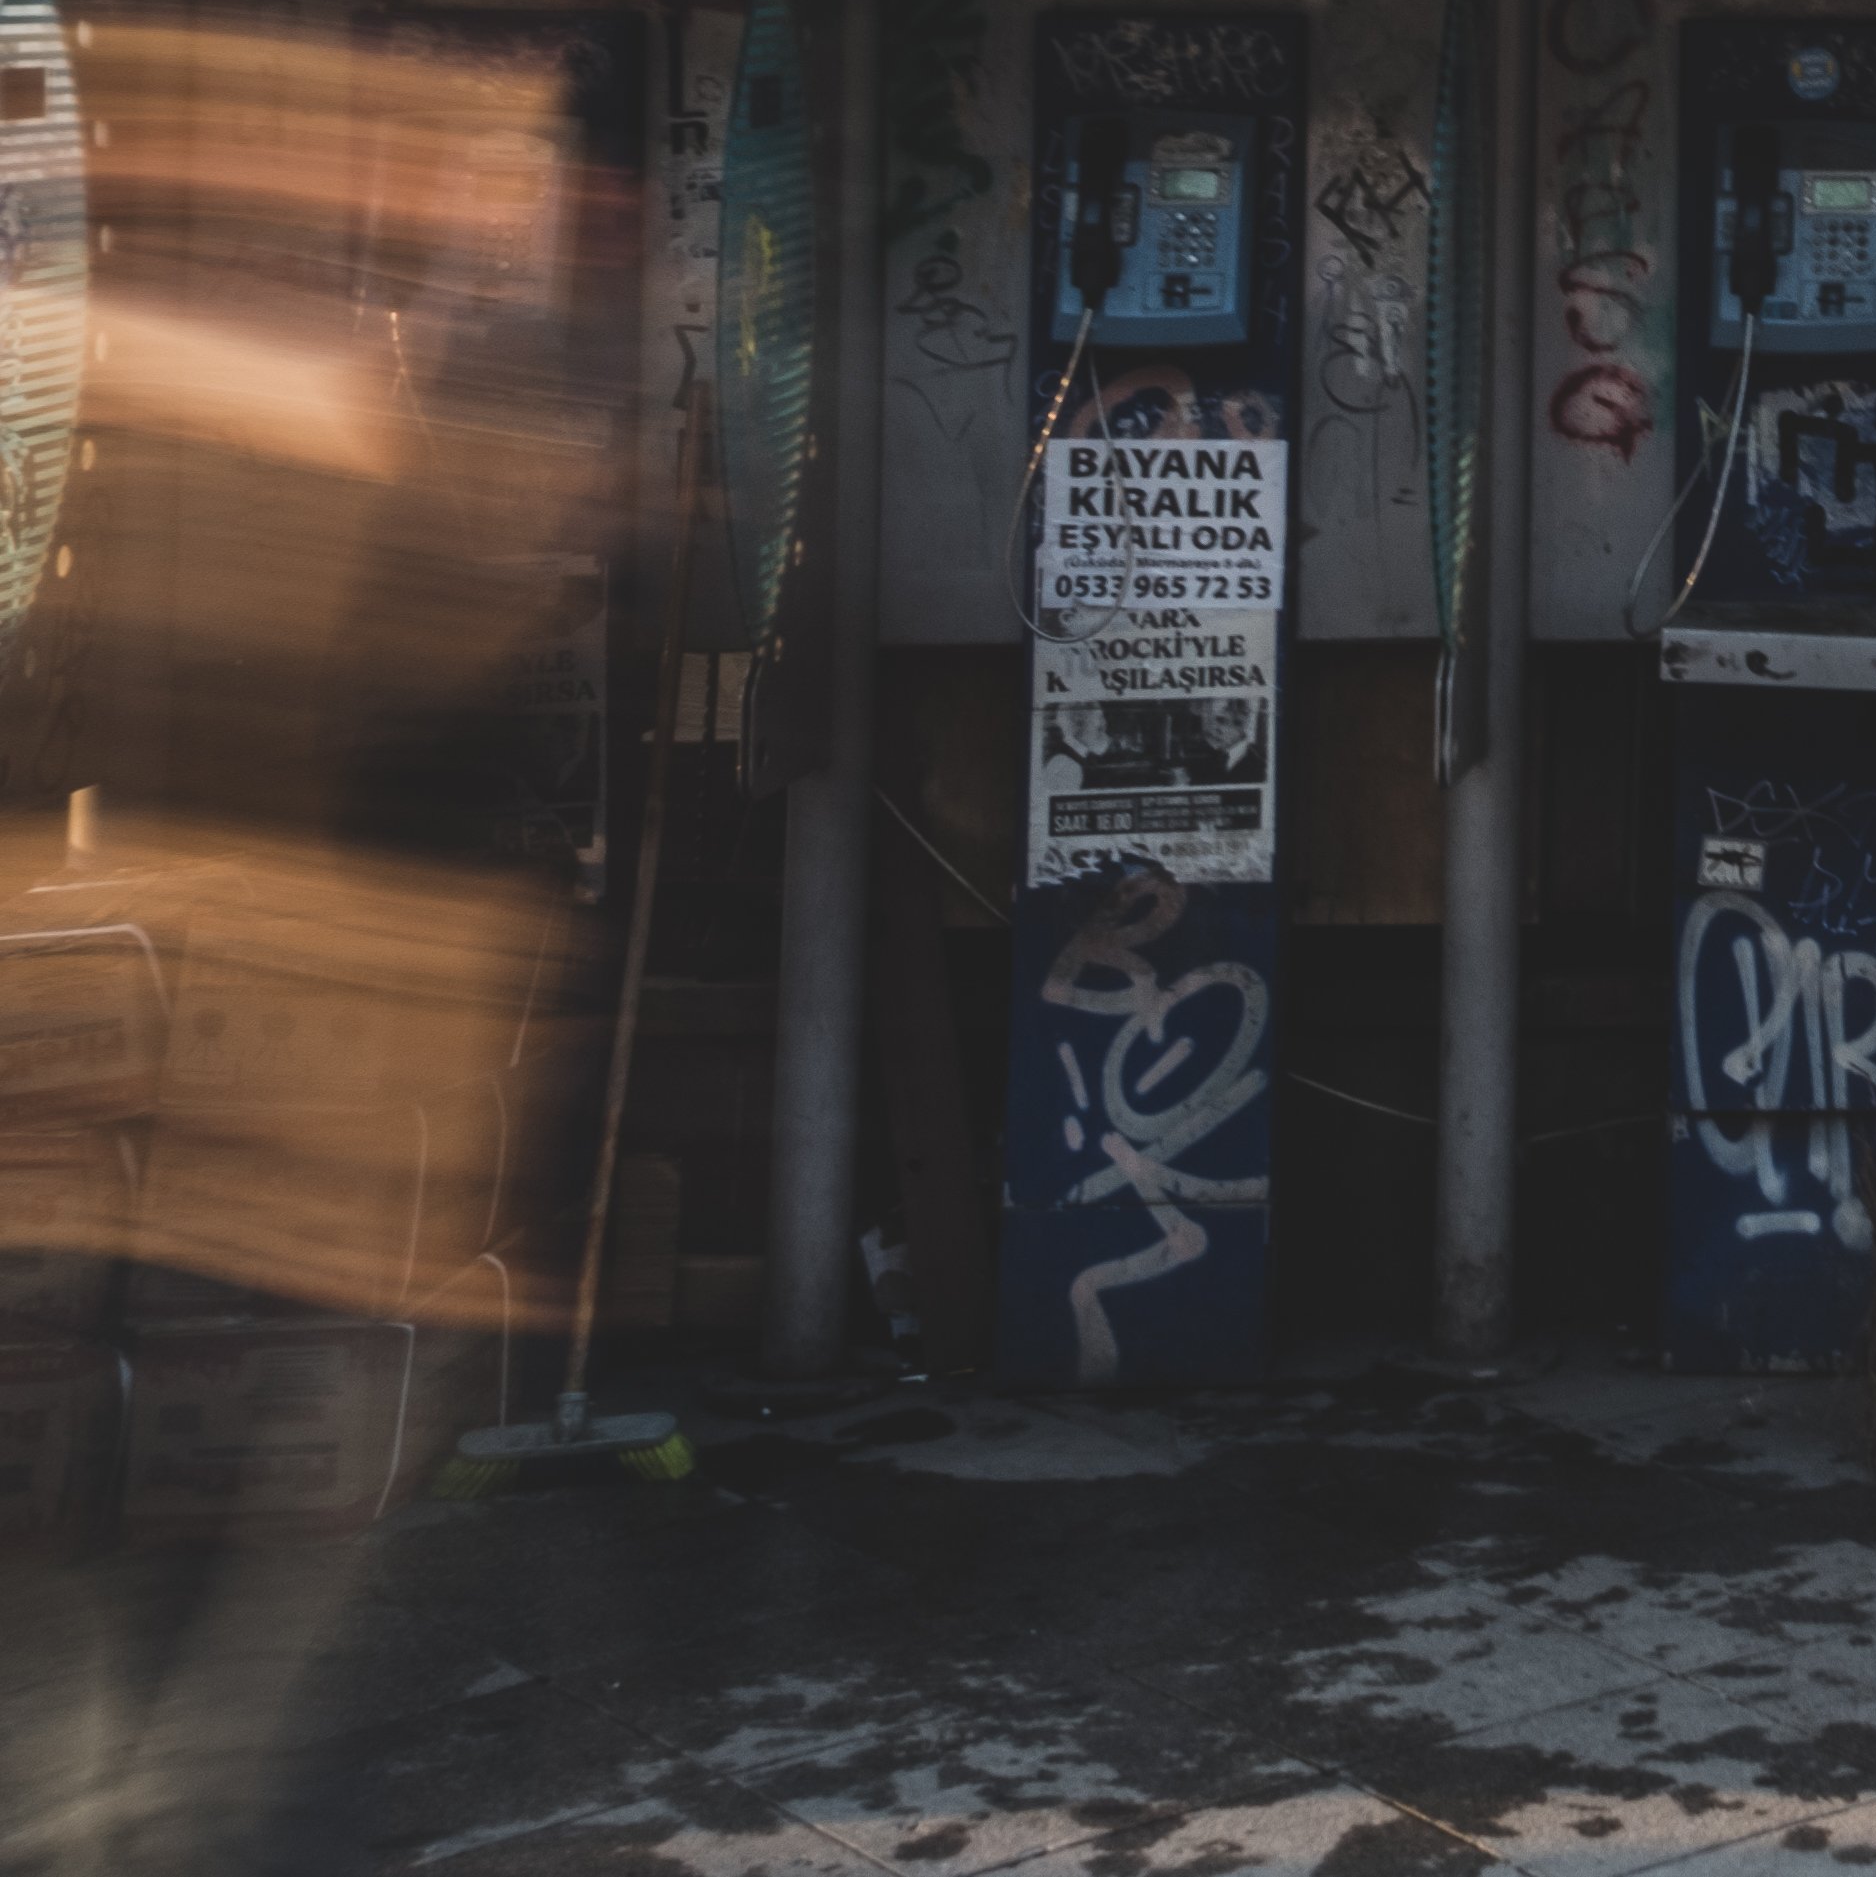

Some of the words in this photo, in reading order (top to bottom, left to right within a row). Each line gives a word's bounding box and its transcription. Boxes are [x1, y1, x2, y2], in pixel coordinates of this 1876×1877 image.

[1068, 446, 1263, 480] BAYANA
[1068, 480, 1261, 518] KİRALIK
[1058, 525, 1182, 556] EŞYALI
[1191, 525, 1273, 552] ODA
[1134, 575, 1187, 599] 965
[1196, 576, 1229, 600] 72
[1237, 576, 1272, 600] 53
